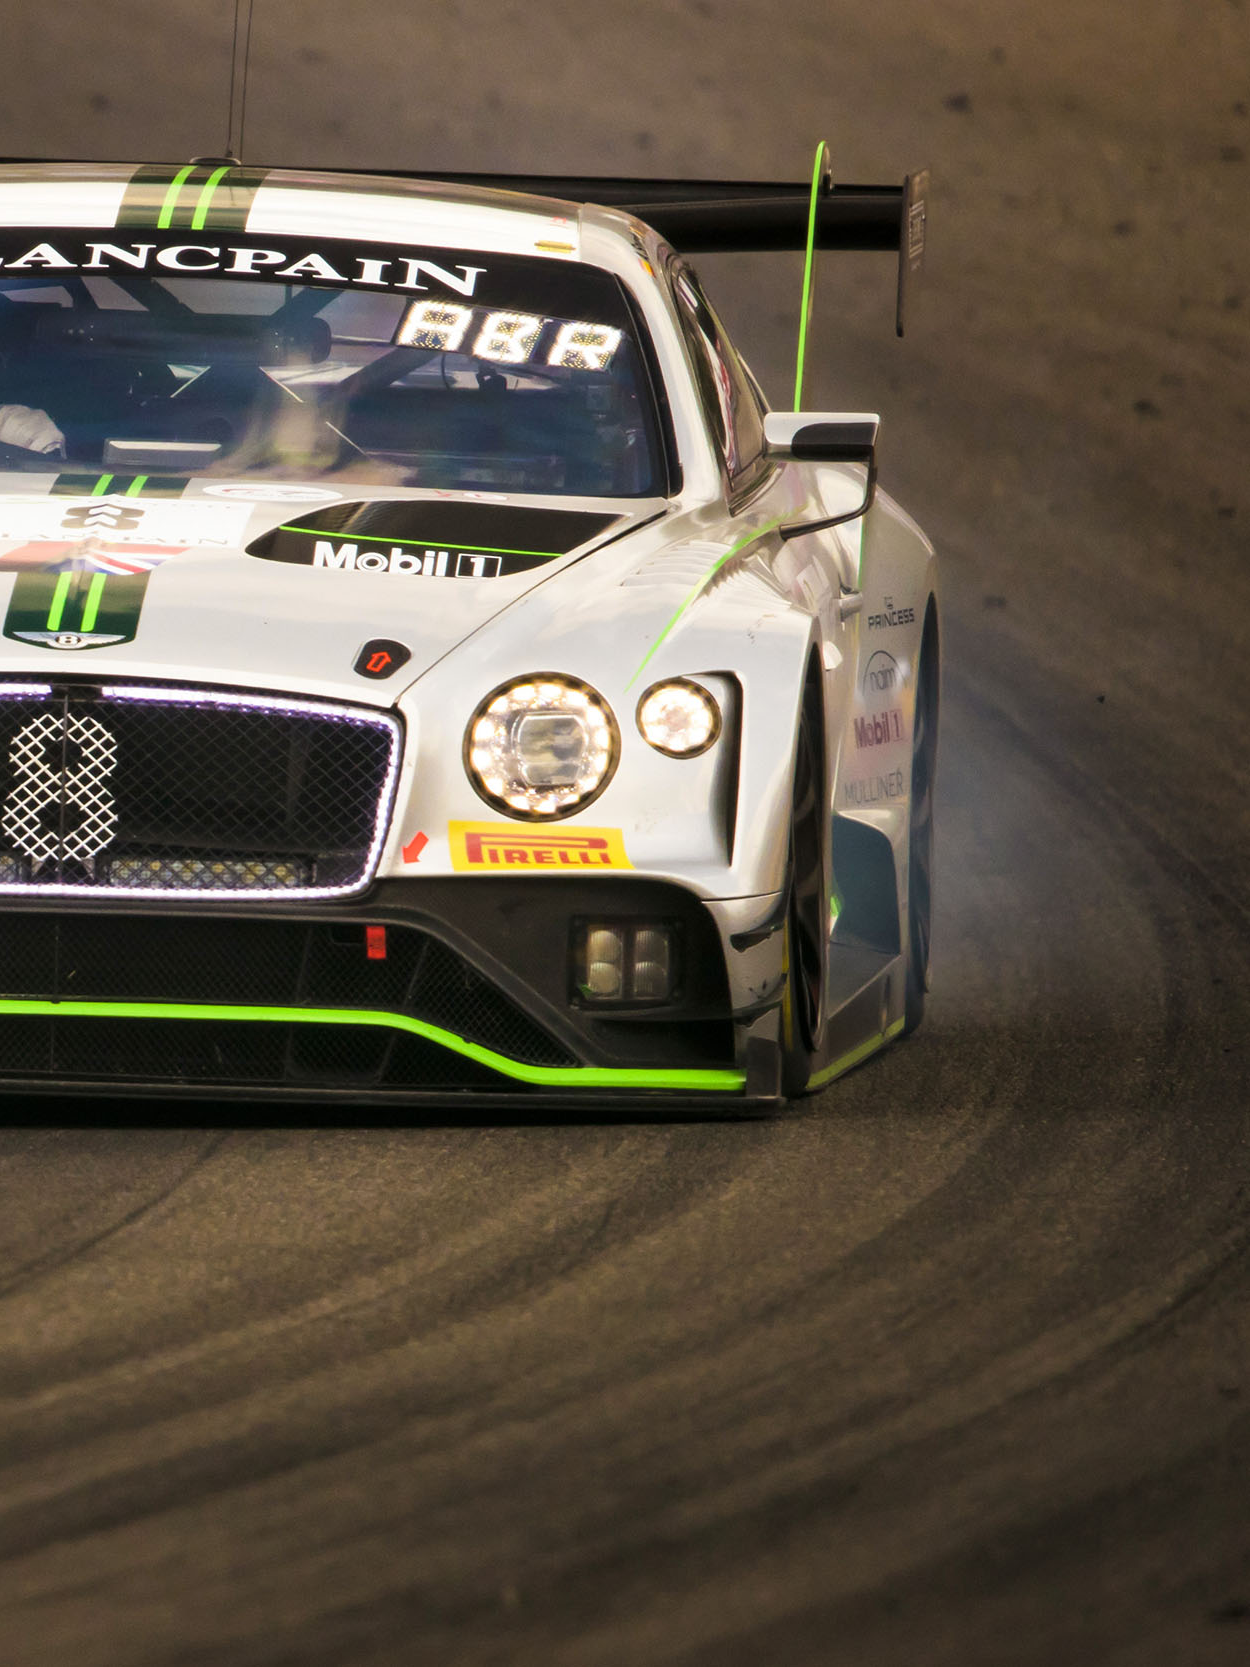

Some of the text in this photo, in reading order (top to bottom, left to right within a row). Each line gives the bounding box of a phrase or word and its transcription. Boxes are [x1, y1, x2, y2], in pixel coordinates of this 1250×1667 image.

[313, 541, 448, 577] Mobil
[867, 607, 915, 629] PRINCESS
[870, 664, 897, 691] naim
[854, 711, 890, 749] Mobil
[1, 713, 118, 861] 8
[845, 771, 903, 806] MULLINER
[465, 832, 611, 864] PIRELLI
